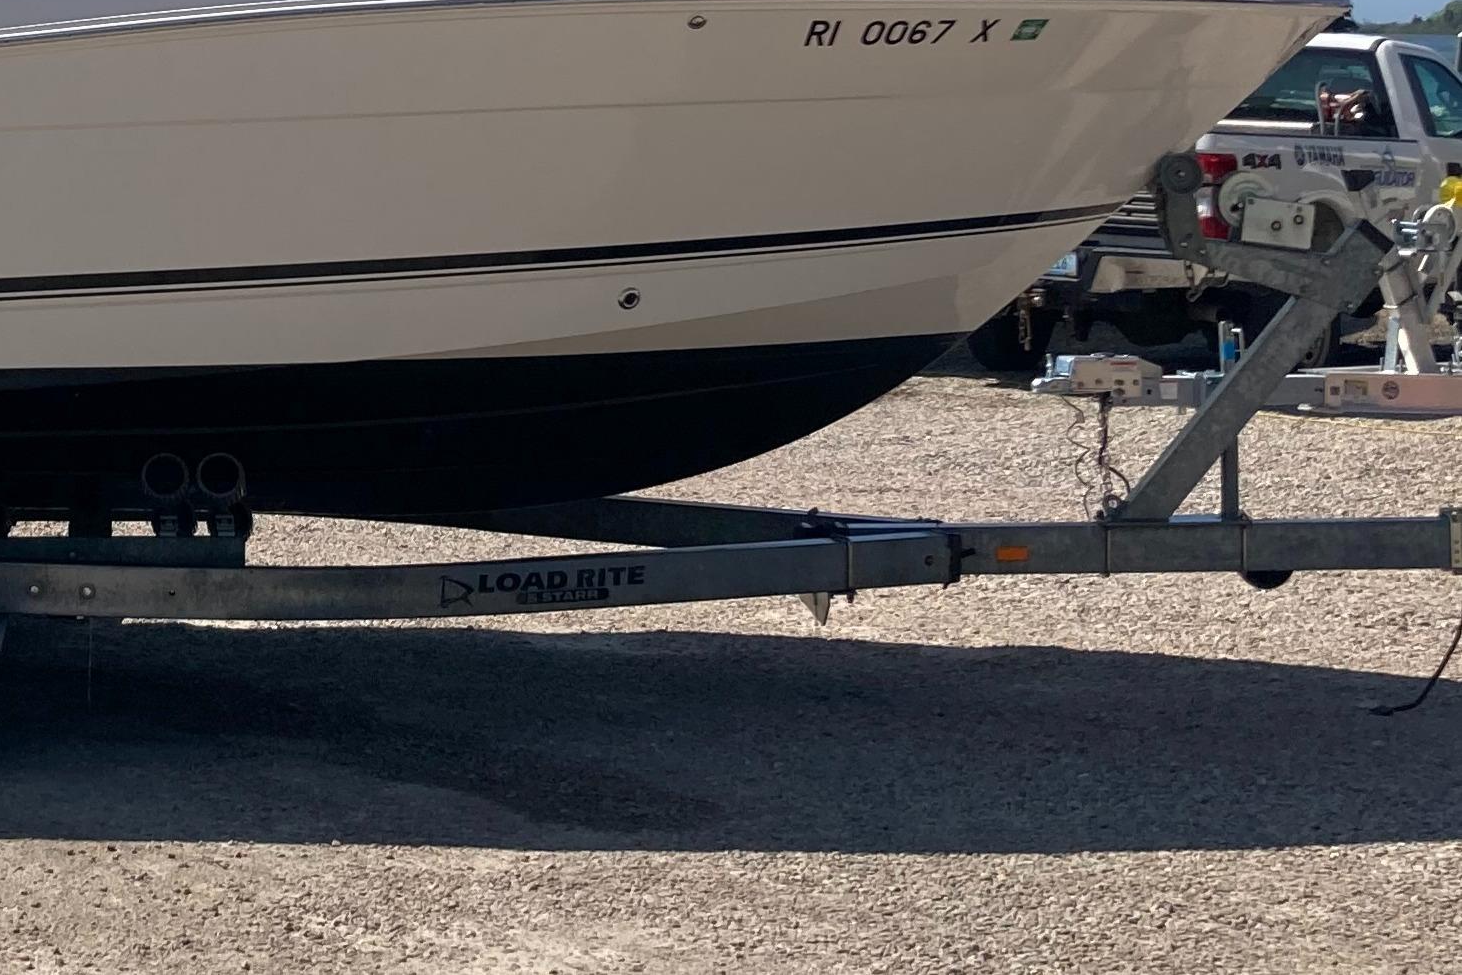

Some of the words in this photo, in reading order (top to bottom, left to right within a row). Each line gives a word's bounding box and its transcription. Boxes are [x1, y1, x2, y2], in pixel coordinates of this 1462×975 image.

[804, 20, 841, 47] RI
[861, 20, 955, 45] 0067
[969, 19, 1000, 43] X
[478, 570, 569, 593] LOAD
[576, 566, 646, 587] RITE
